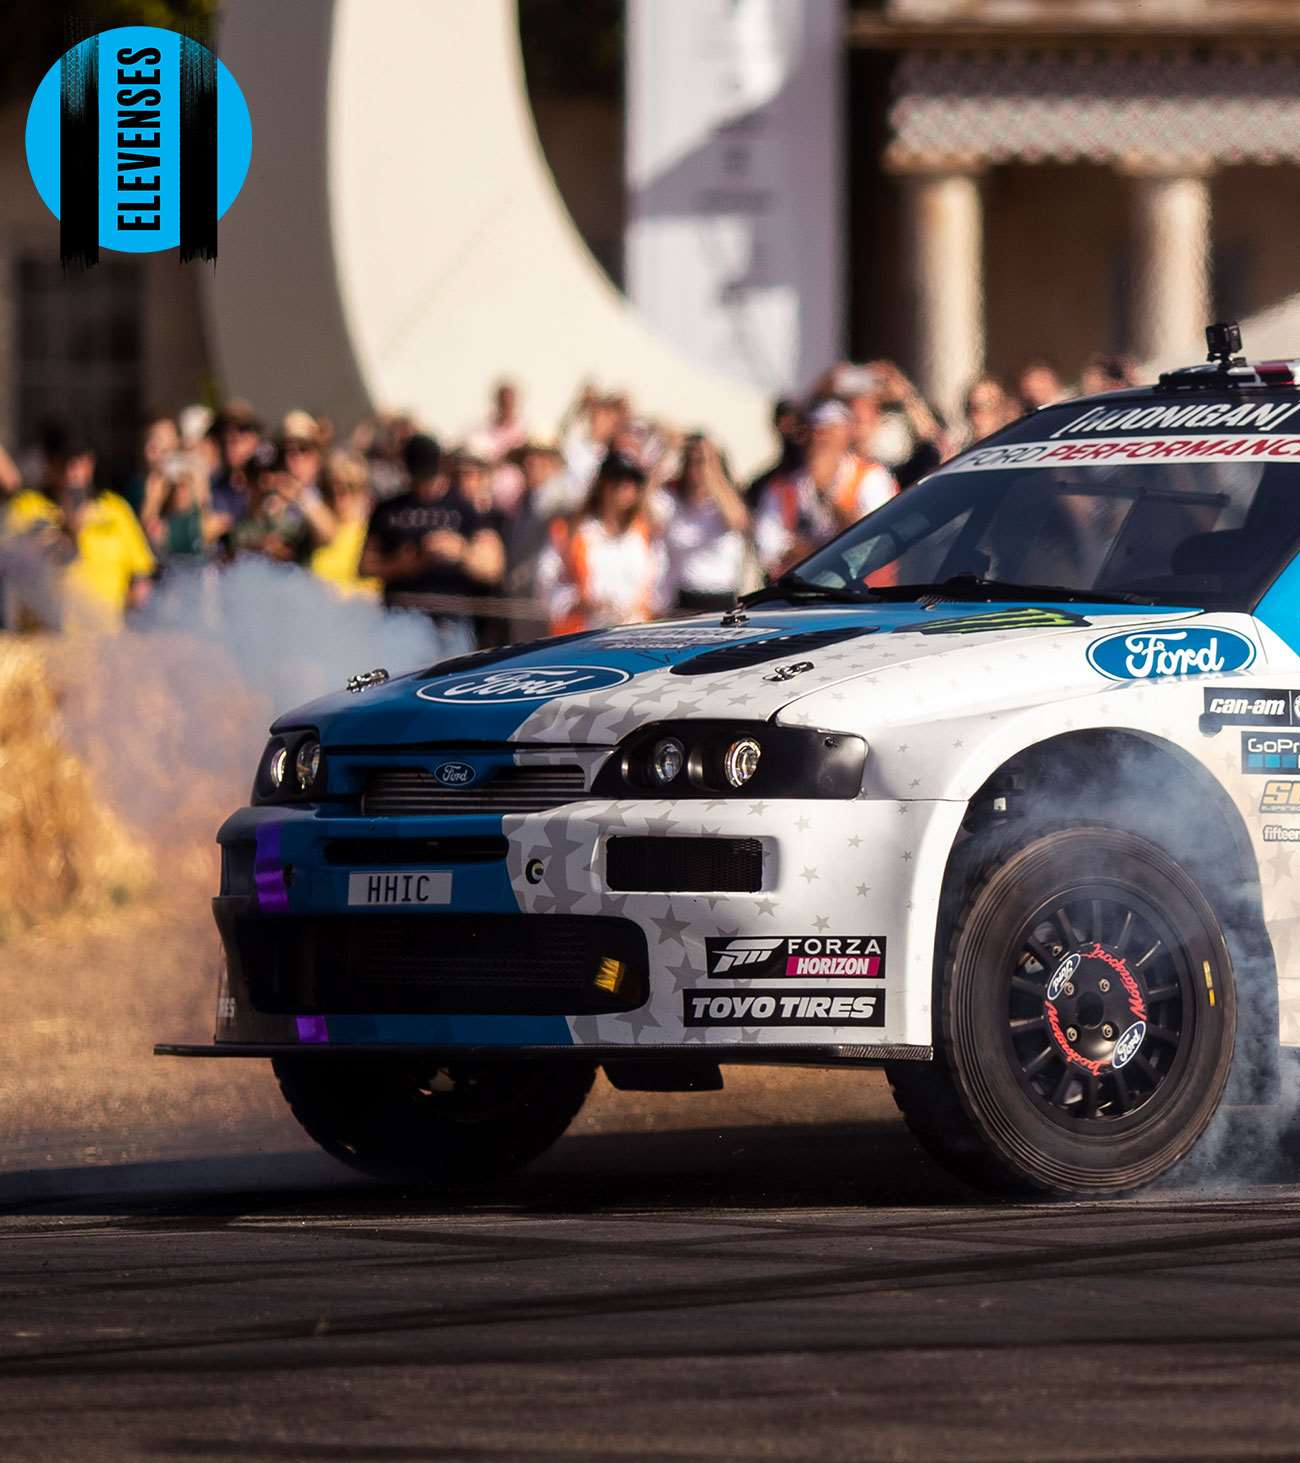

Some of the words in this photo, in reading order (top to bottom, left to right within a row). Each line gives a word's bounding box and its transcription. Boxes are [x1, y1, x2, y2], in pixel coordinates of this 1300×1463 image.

[1125, 631, 1224, 678] Ford
[444, 669, 595, 696] Ford
[1209, 698, 1286, 715] can-am
[442, 765, 468, 782] Ford
[367, 875, 430, 903] HHIC
[788, 938, 881, 955] FORZA
[796, 957, 869, 975] HORIZON
[691, 996, 776, 1019] TOYO
[779, 996, 876, 1019] TIRES
